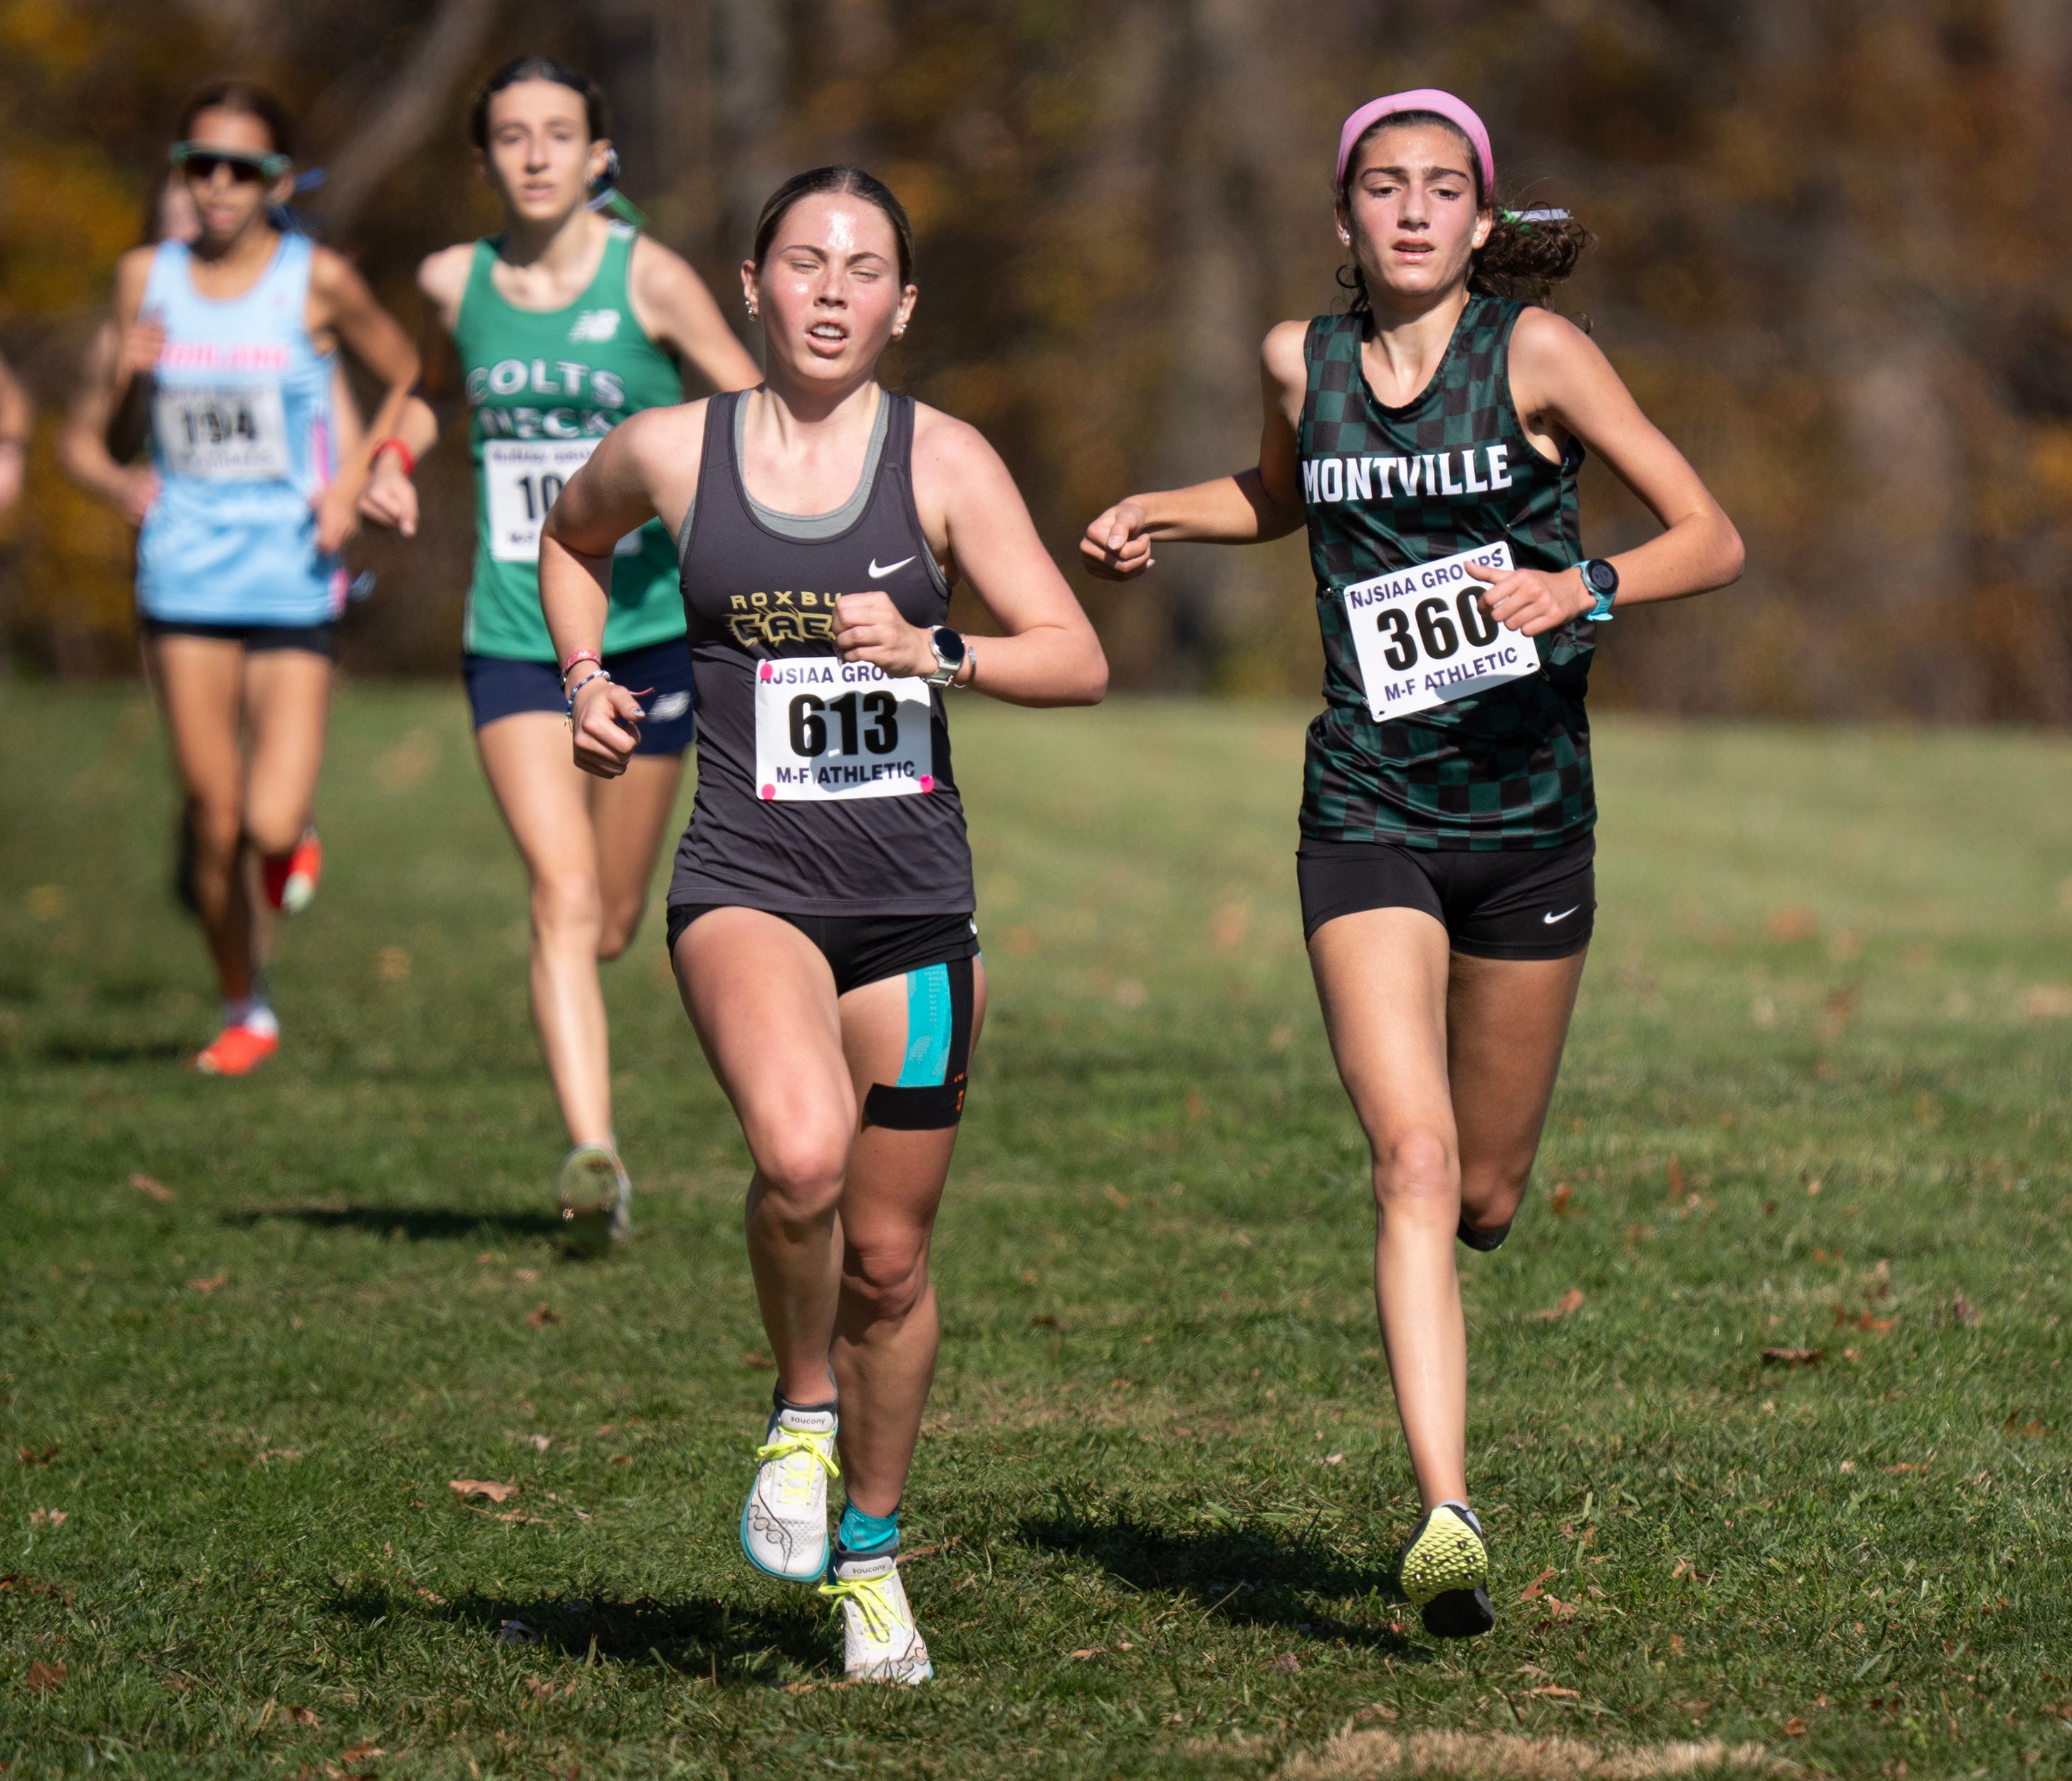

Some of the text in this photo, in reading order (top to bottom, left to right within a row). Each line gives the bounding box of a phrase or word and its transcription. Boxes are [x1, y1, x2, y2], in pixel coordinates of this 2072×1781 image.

[466, 359, 625, 409] COLTS
[518, 474, 563, 520] 10
[1302, 445, 1512, 504] MONTVILLE
[730, 591, 842, 609] ROXBU
[1352, 549, 1504, 609] NJSIAA GROPS
[727, 611, 837, 648] GAE
[1376, 586, 1499, 671] 360
[842, 665, 894, 682] GRO
[1384, 647, 1518, 701] M-F ATHLETIC
[788, 690, 898, 757] 613
[776, 760, 915, 784] M-F ATHLETIC
[791, 1416, 826, 1425] saucony
[853, 1564, 886, 1574] saucony
